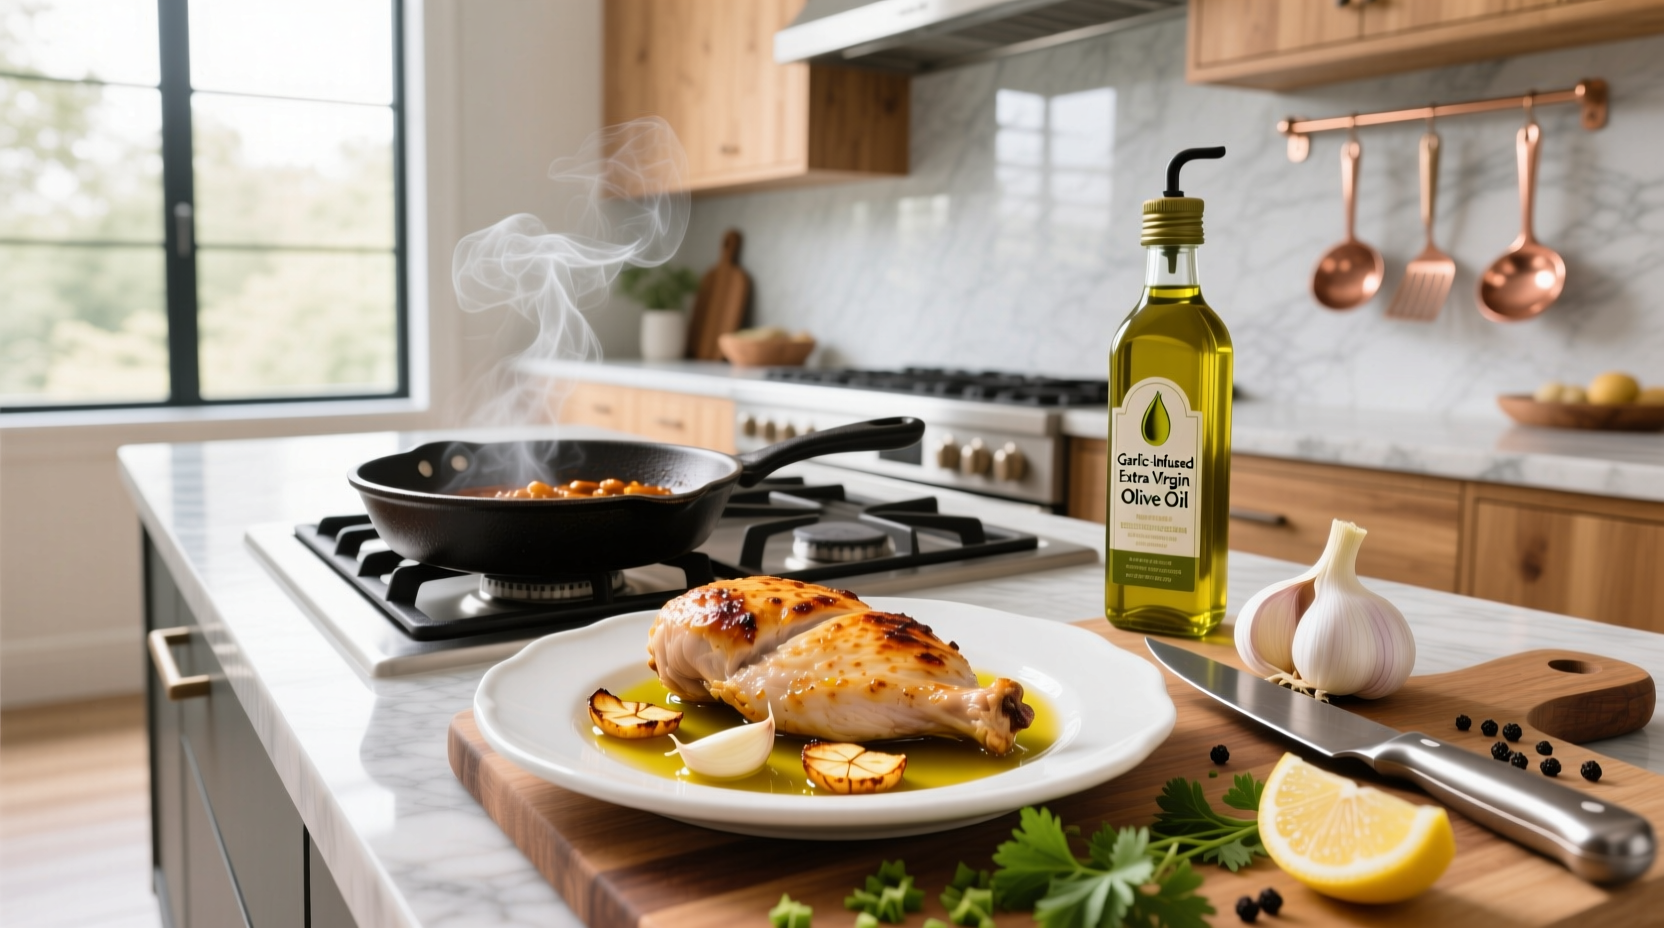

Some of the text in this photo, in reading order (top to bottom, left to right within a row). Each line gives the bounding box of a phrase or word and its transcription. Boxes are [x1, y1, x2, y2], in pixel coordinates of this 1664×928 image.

[1119, 469, 1149, 484] Extra
[1121, 488, 1188, 508] Olive Oil
